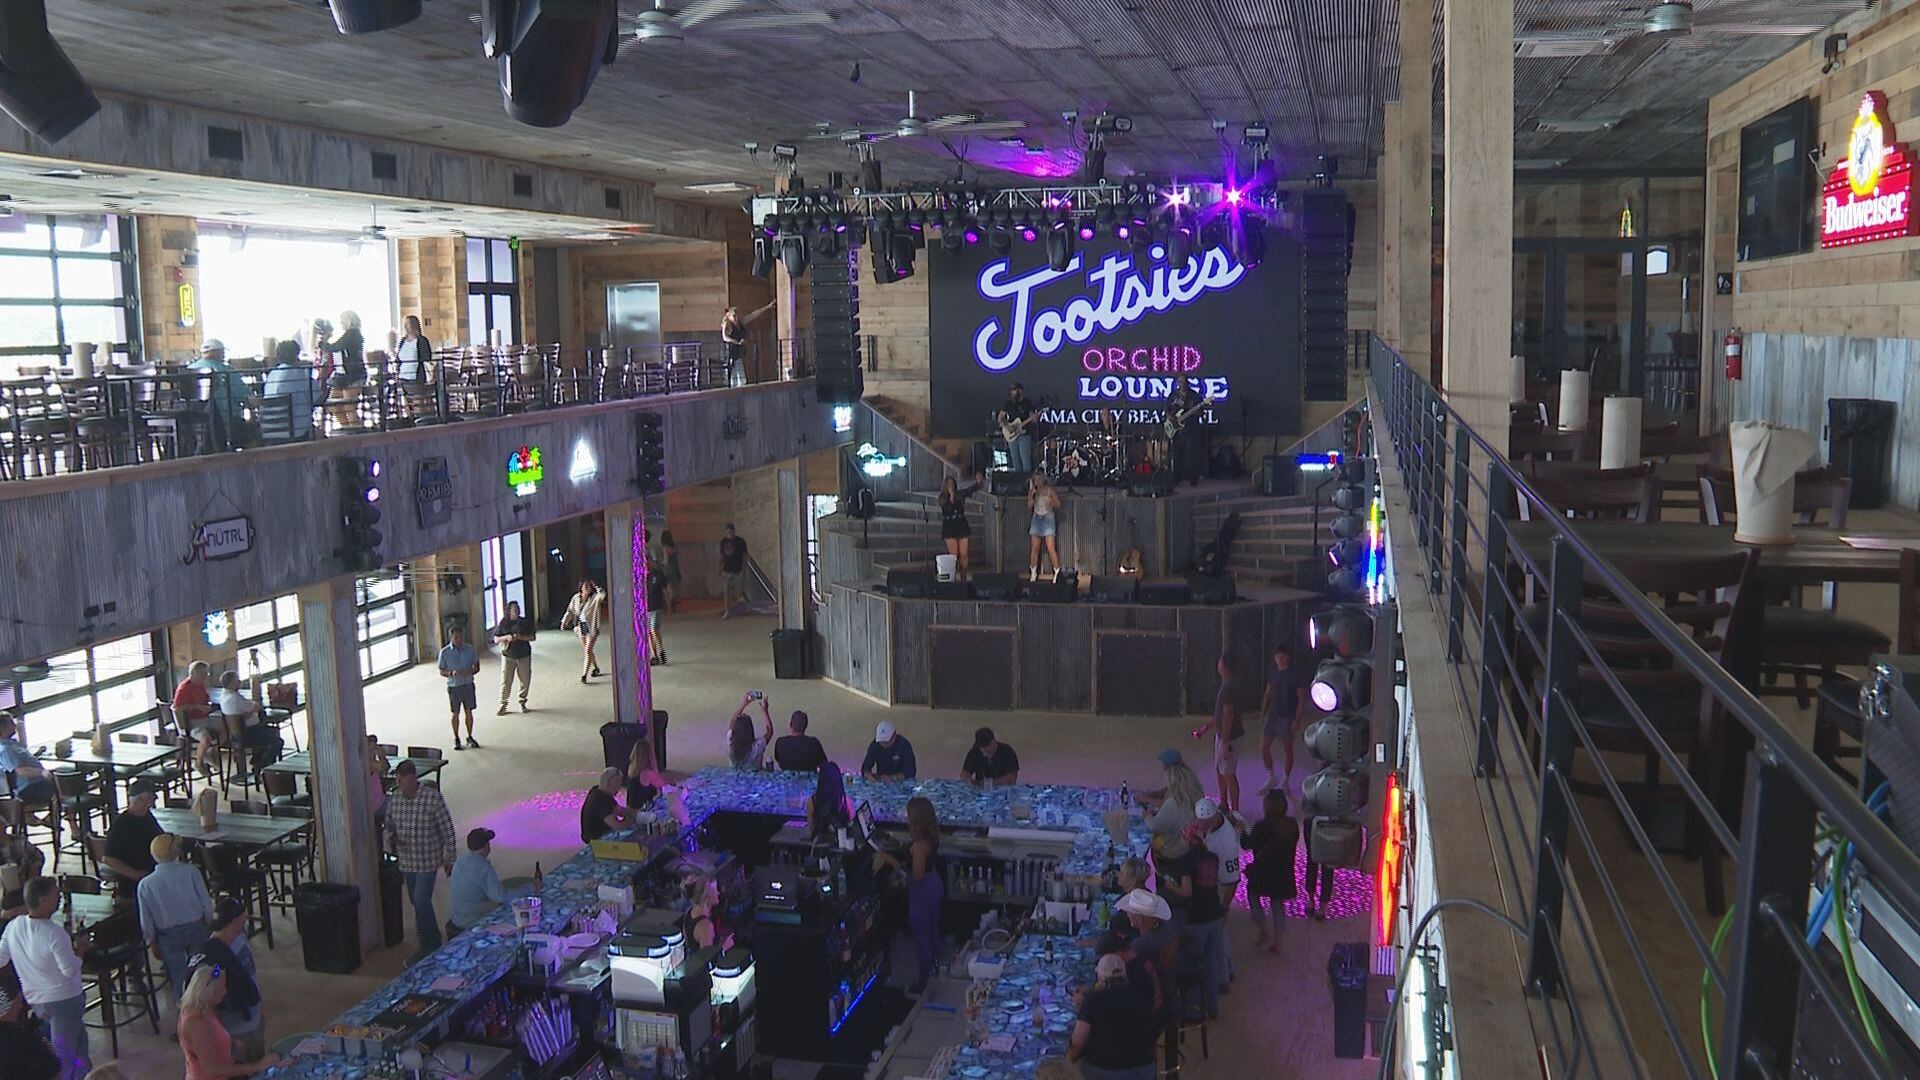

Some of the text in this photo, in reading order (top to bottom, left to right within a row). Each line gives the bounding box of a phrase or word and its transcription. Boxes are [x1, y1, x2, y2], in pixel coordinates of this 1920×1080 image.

[1824, 186, 1906, 235] Budweiser
[975, 244, 1245, 370] Tootsies
[1083, 346, 1203, 372] ORCHID
[1081, 409, 1124, 424] CIY
